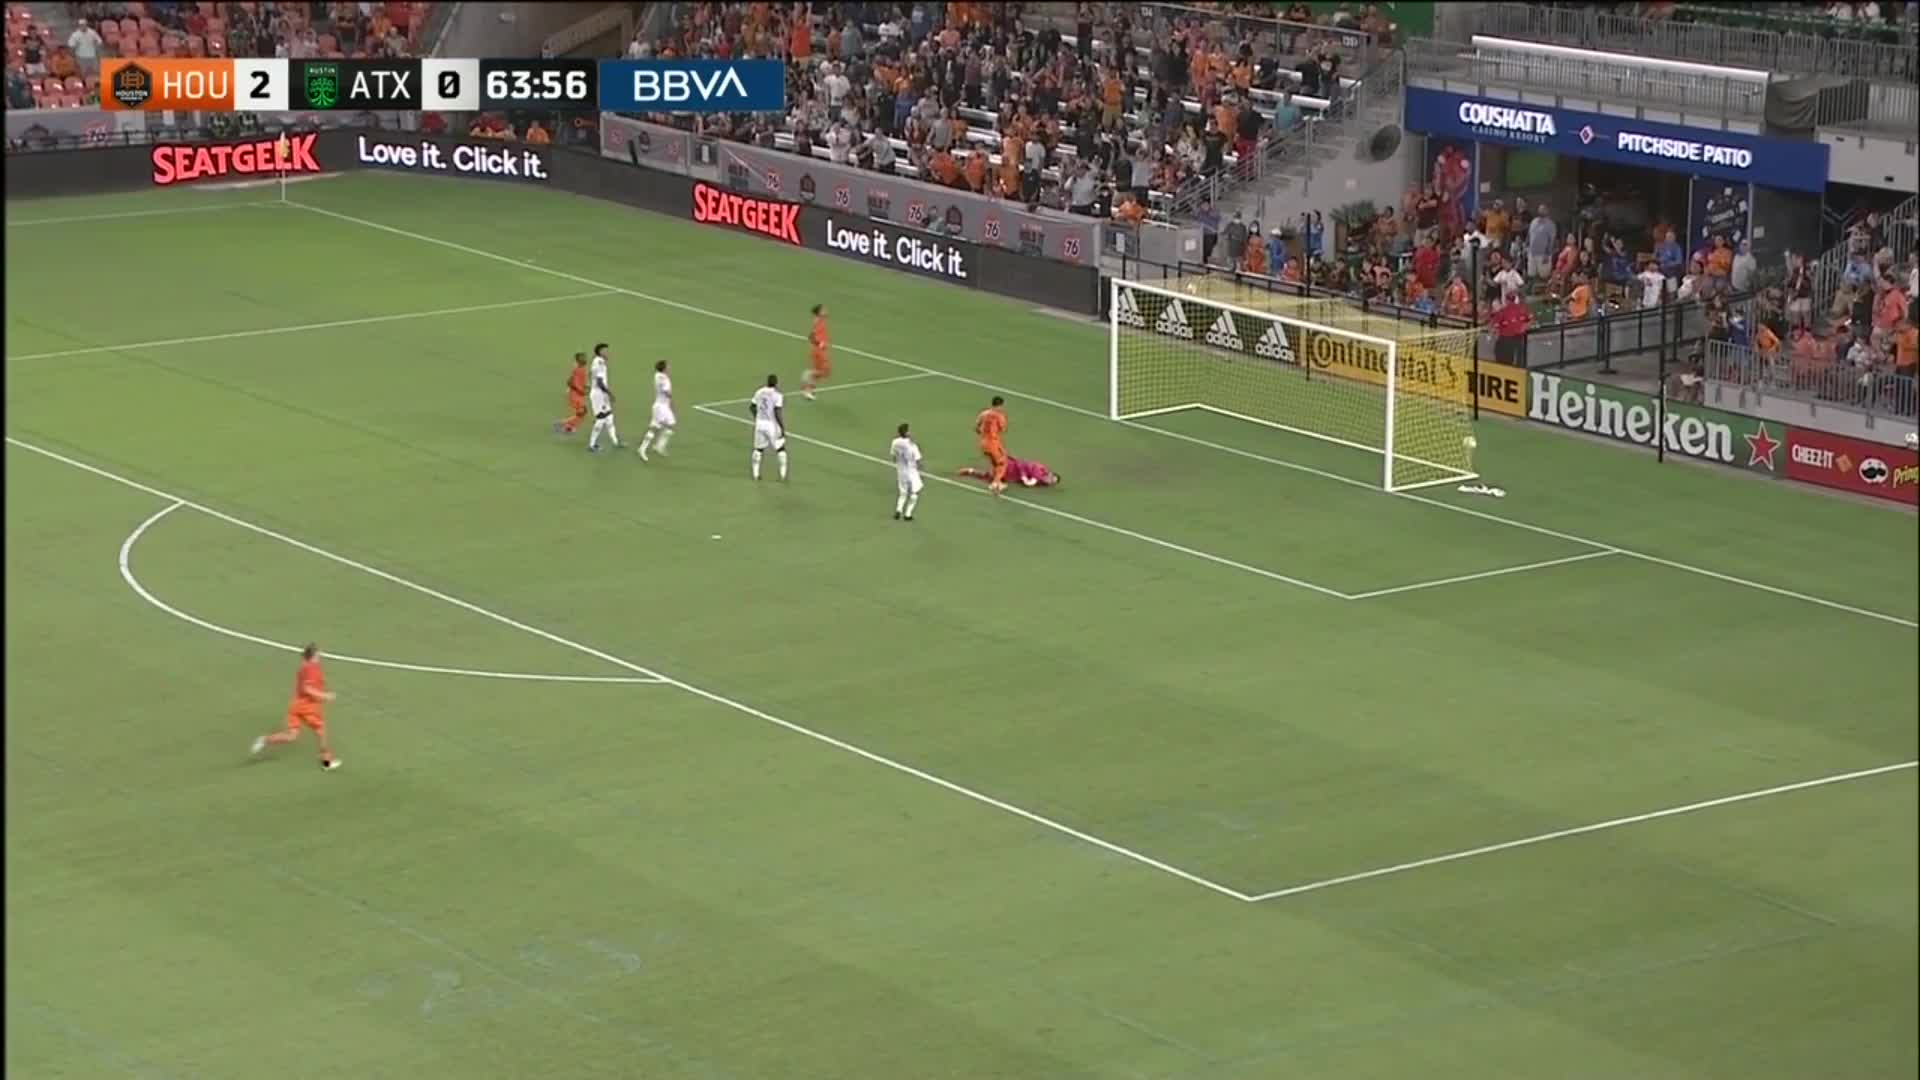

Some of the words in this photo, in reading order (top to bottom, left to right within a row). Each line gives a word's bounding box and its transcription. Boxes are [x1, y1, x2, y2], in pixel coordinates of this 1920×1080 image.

[1460, 101, 1557, 136] COUSHATTA
[153, 133, 321, 184] SEATGEEK
[358, 136, 416, 166] Love
[422, 142, 447, 169] it.
[453, 145, 517, 175] Click
[524, 150, 547, 178] it.
[1618, 131, 1702, 161] PITCHSIDE
[1703, 144, 1752, 168] PATIO
[693, 183, 800, 245] SEATGEEK
[826, 219, 870, 255] Love
[872, 229, 892, 260] it.
[896, 236, 944, 273] Click
[946, 246, 967, 279] it.
[1155, 320, 1194, 339] adidas
[1205, 331, 1244, 351] adidas
[1255, 343, 1296, 362] adidas
[1466, 370, 1520, 404] TIRE
[1529, 371, 1735, 463] Heineken
